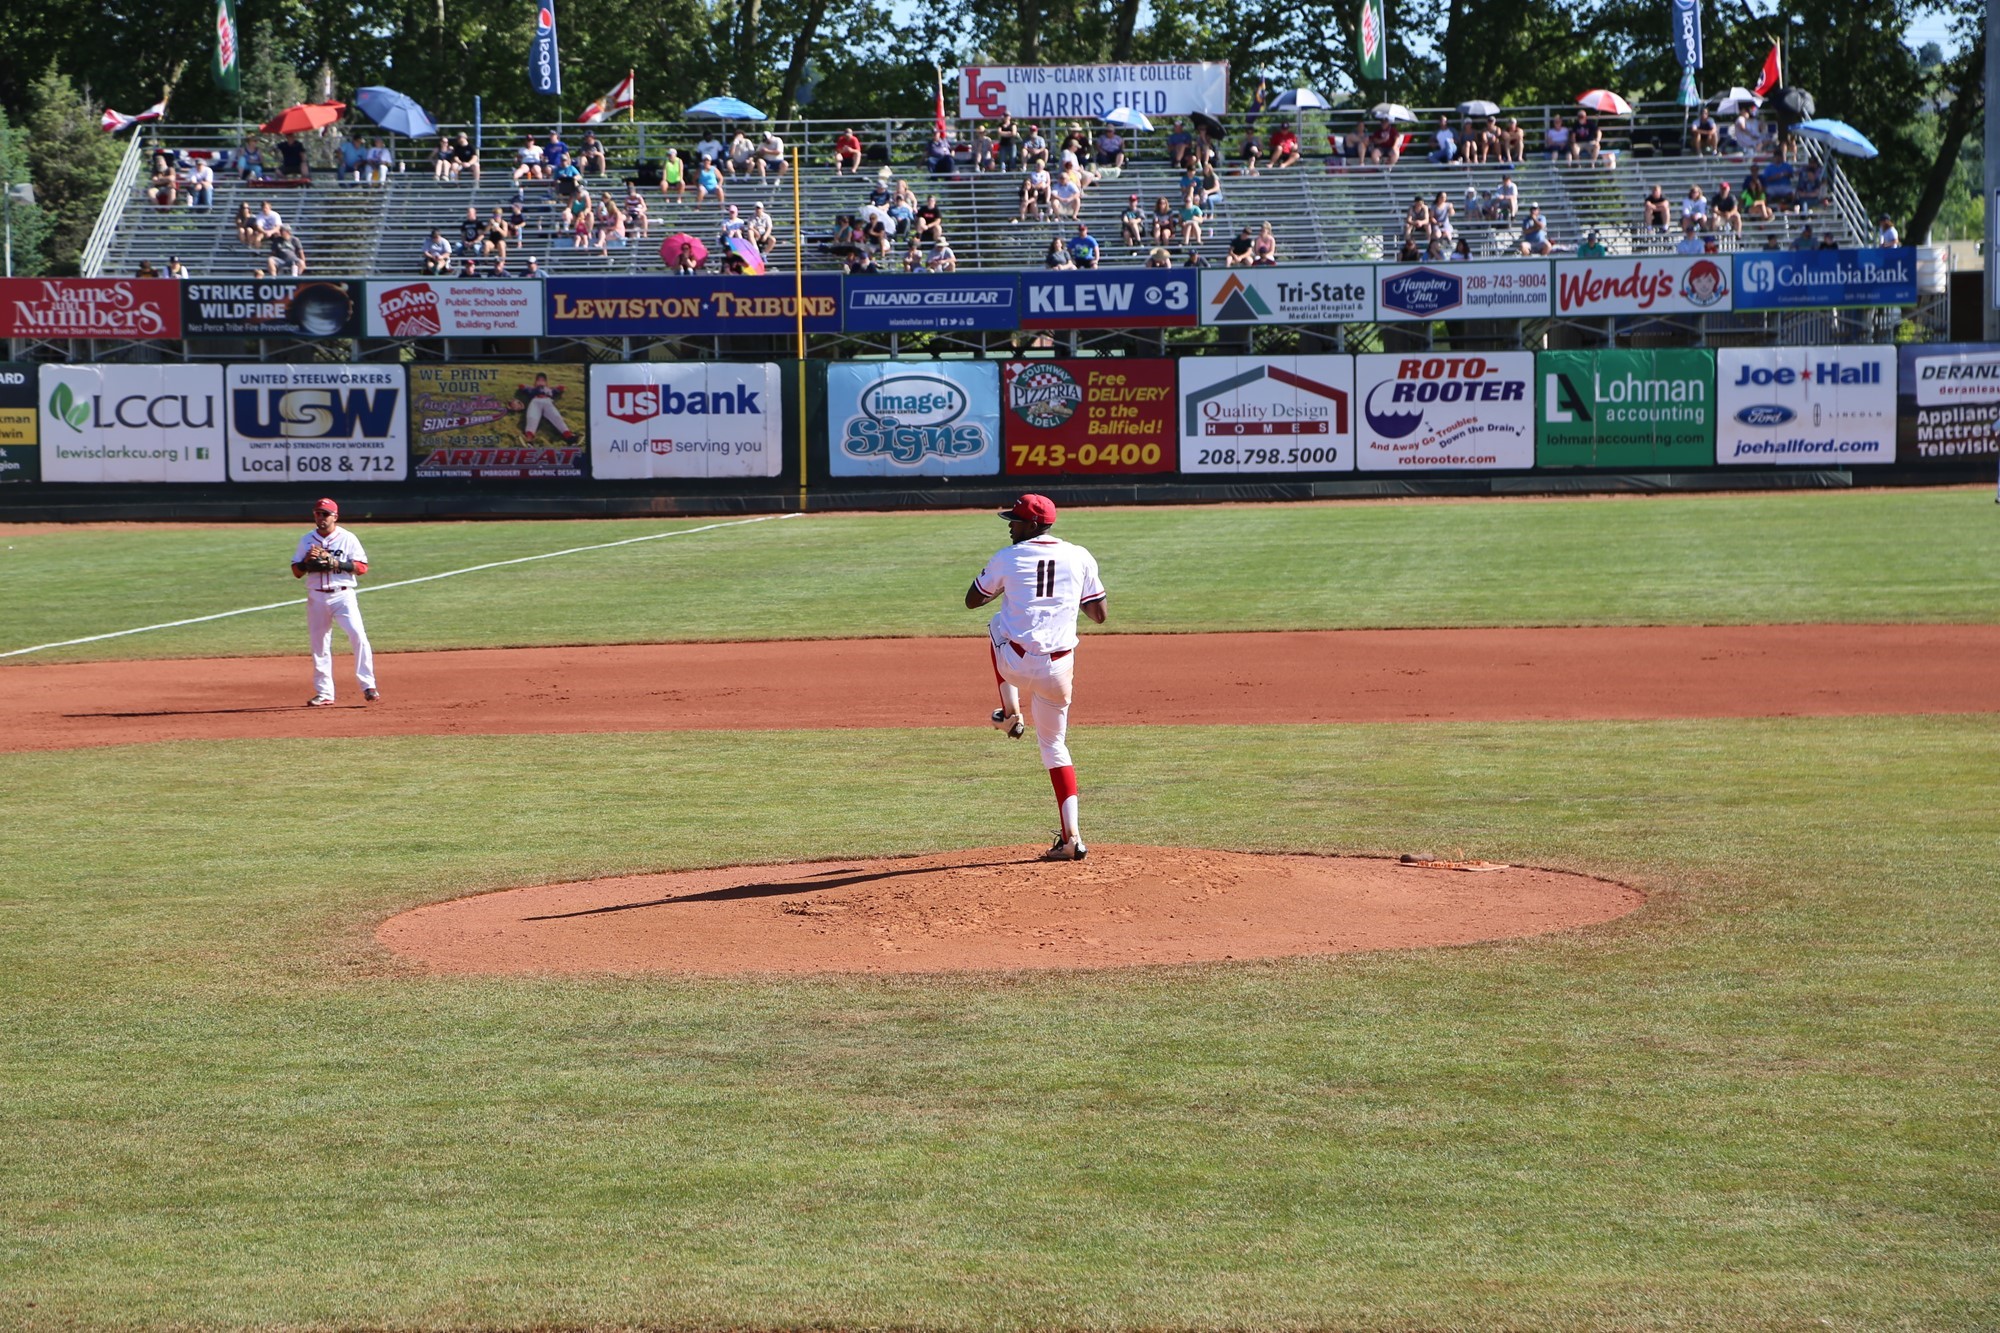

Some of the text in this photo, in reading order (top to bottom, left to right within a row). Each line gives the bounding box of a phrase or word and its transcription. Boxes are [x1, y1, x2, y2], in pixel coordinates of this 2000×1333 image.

[1007, 65, 1193, 83] LEWIS-CLARK STATE COLLEGE
[1028, 90, 1168, 117] HARRIS FIELD
[1466, 274, 1547, 290] 208-743-9004
[1777, 260, 1909, 287] Columbia Bank
[188, 285, 297, 300] STRIKE OUT
[450, 287, 522, 297] Benefiting Idaho
[1277, 282, 1366, 302] Tri-State
[1393, 278, 1452, 295] Hampton
[1560, 261, 1674, 312] Wendy's
[474, 298, 508, 306] Schools
[510, 298, 527, 306] and
[554, 292, 836, 319] LEWISTON TRIBUNE
[864, 291, 998, 306] INLAND CELLULAR
[1029, 281, 1189, 313] KLEW 3
[1406, 291, 1439, 304] Inn
[1466, 290, 1547, 307] hamptoninn.com
[200, 303, 286, 319] WILDFIRE
[388, 305, 433, 321] LOTTERY
[454, 309, 520, 318] the Permanent
[1280, 304, 1319, 312] Memorial
[1321, 303, 1356, 312] Hospital
[1289, 312, 1354, 321] Medical Campus
[204, 323, 224, 332] Perce
[226, 323, 244, 332] Tribe
[245, 323, 259, 332] Fire
[260, 323, 299, 332] Prevention
[456, 321, 518, 330] Building Fund.
[419, 369, 499, 381] WE PRINT
[1021, 363, 1071, 382] SOUTHWAY
[1397, 358, 1498, 380] ROTO-
[1735, 362, 1880, 387] Joe Hall
[240, 373, 393, 385] UNITED STEELWORKERS
[1088, 371, 1127, 386] Free
[438, 382, 480, 393] YOUR
[1013, 385, 1080, 407] PIZZERIA
[1088, 386, 1170, 402] DELIVERY
[1392, 381, 1525, 403] ROOTER
[1595, 372, 1705, 403] Lohman
[93, 395, 215, 428] LCCU
[875, 391, 954, 415] image!
[1088, 404, 1138, 418] to the
[1203, 401, 1328, 421] Quality Design
[232, 388, 399, 440] USW
[1606, 404, 1705, 425] accounting
[1748, 407, 1783, 424] Ford
[1829, 411, 1883, 419] LINCOLN
[423, 417, 459, 431] SINCE
[845, 416, 985, 464] Signs
[1370, 416, 1478, 452] And Away Go Troubles
[1439, 423, 1515, 449] Down the Drain
[1547, 433, 1705, 447] lohmanaccounting.com
[56, 445, 178, 462] lewisclarkcu.org
[610, 439, 762, 455] All of us serving you
[1011, 443, 1161, 467] 743-0400
[1198, 447, 1337, 464] 208.798.5000
[1733, 438, 1880, 457] joehallford.com
[242, 456, 395, 472] Local 608 & 712
[419, 448, 582, 468] ARTBEAT
[1399, 454, 1496, 465] rotorooter.com
[1036, 560, 1056, 597] 11
